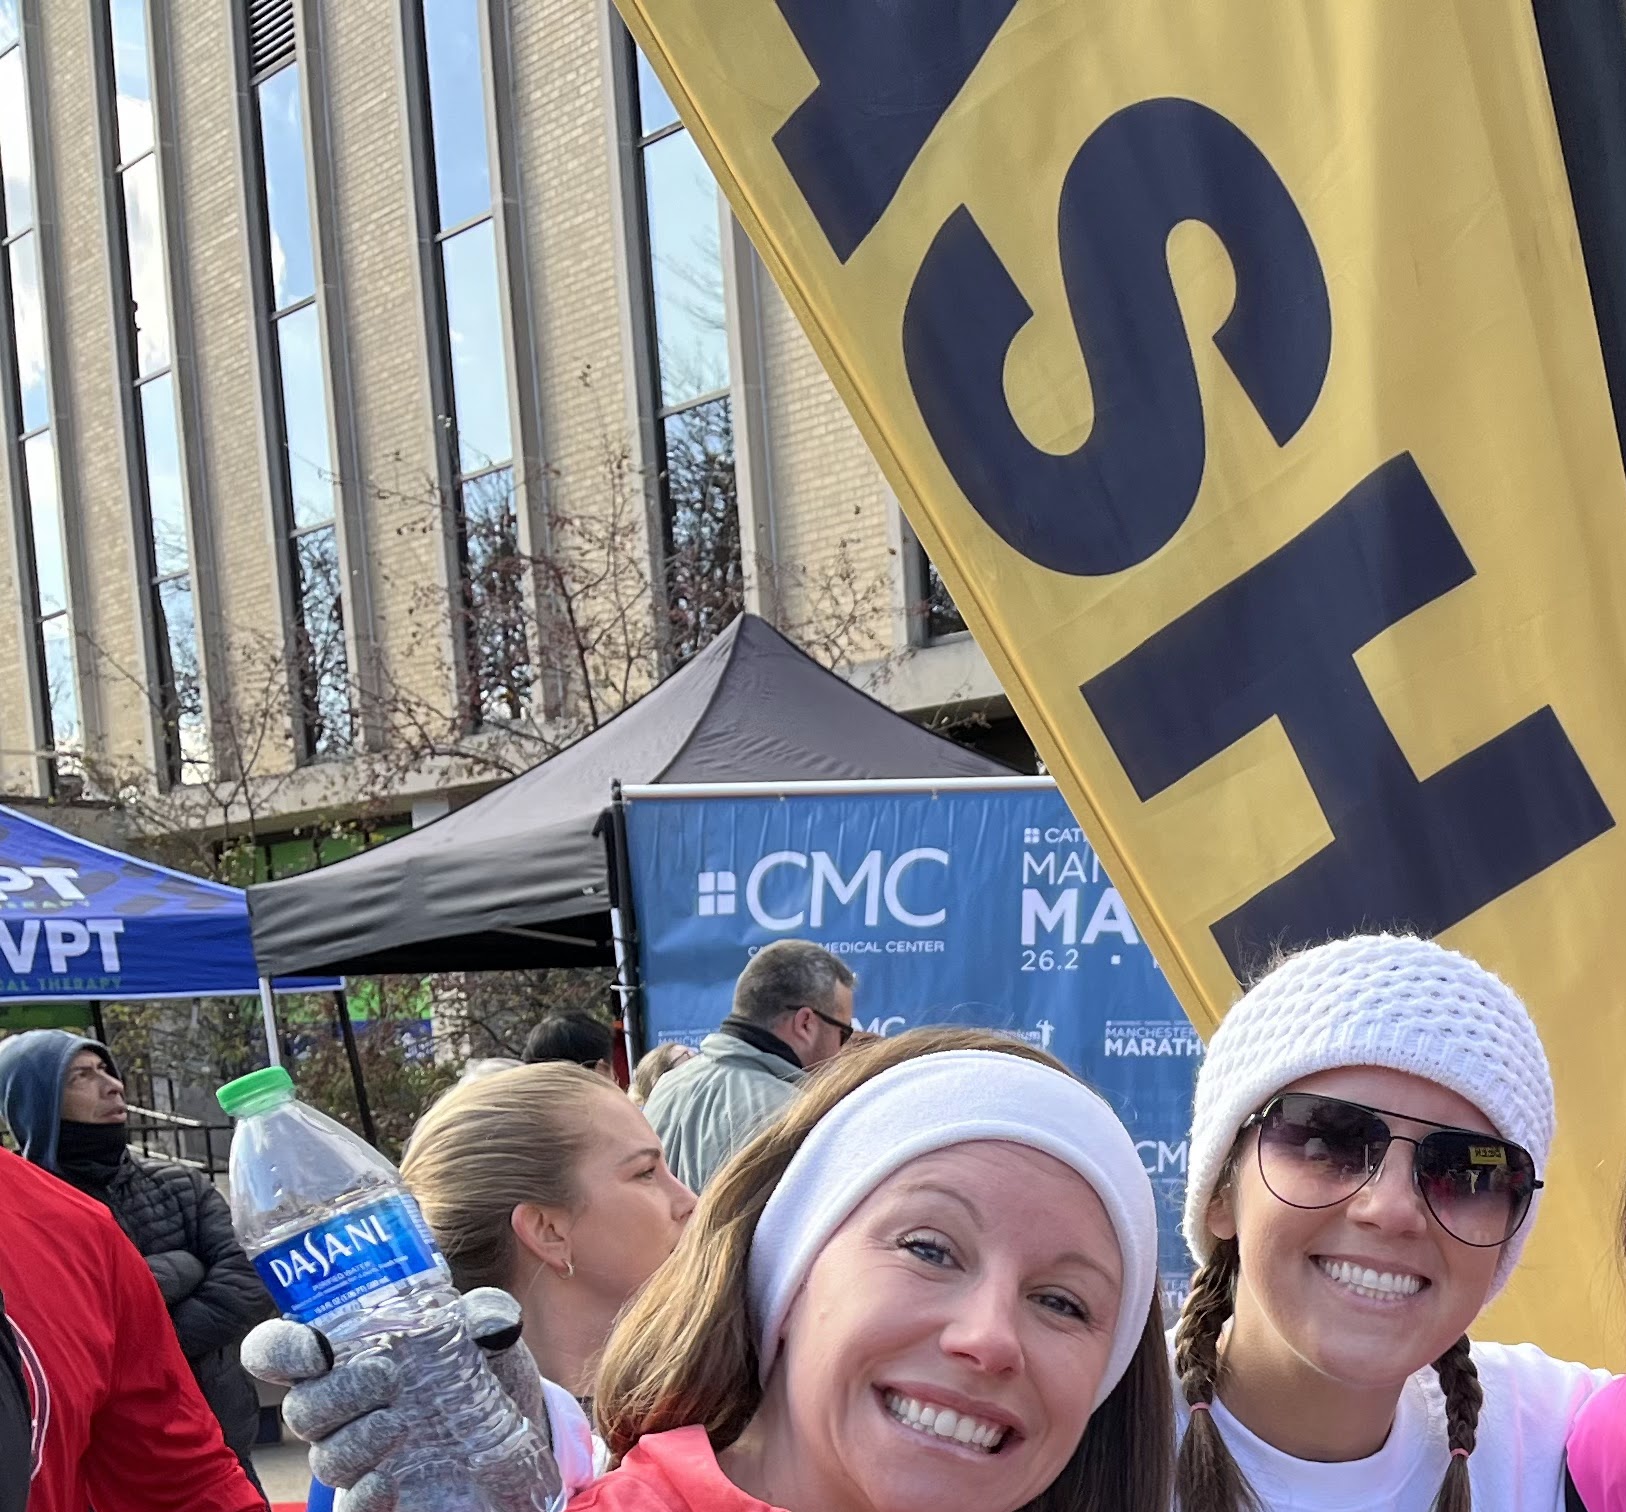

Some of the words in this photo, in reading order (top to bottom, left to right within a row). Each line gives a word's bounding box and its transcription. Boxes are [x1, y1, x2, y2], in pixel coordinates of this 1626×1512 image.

[746, 848, 948, 930] CMC
[886, 940, 945, 953] CENTER
[1020, 949, 1080, 971] 26.2
[852, 1016, 906, 1038] MC
[1104, 1038, 1202, 1057] MARATH
[1135, 1140, 1188, 1173] CM
[269, 1214, 392, 1288] DASANI
